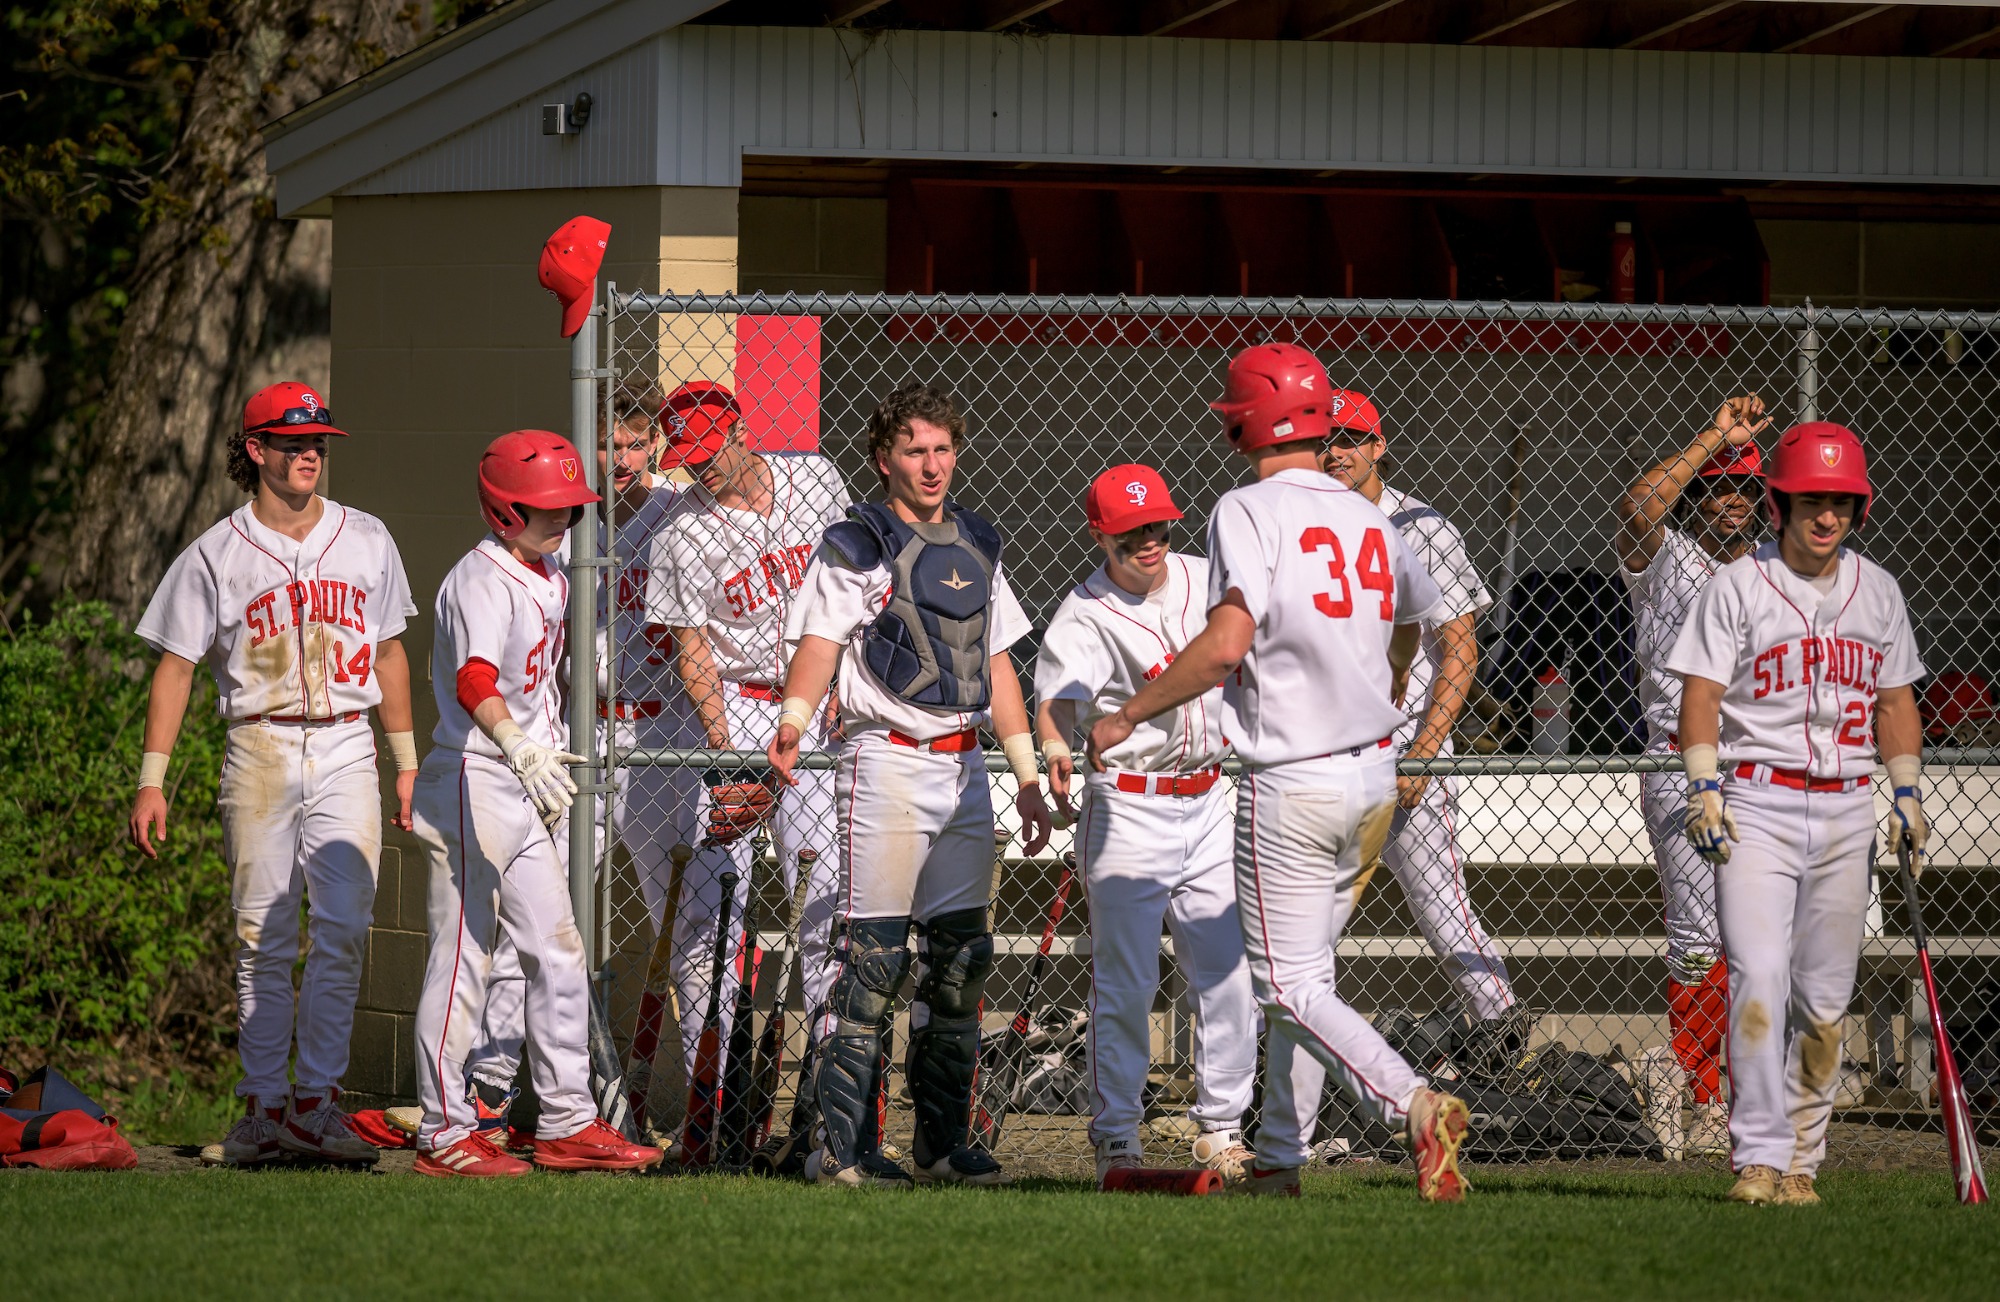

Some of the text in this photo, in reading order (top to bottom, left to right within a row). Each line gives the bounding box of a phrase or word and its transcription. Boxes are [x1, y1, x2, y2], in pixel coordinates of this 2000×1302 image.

[1299, 527, 1393, 622] 34
[246, 580, 366, 648] ST. PAUL'S
[333, 641, 370, 686] 14
[1754, 636, 1884, 700] ST. PAUL'S
[1109, 1140, 1128, 1151] NIKE
